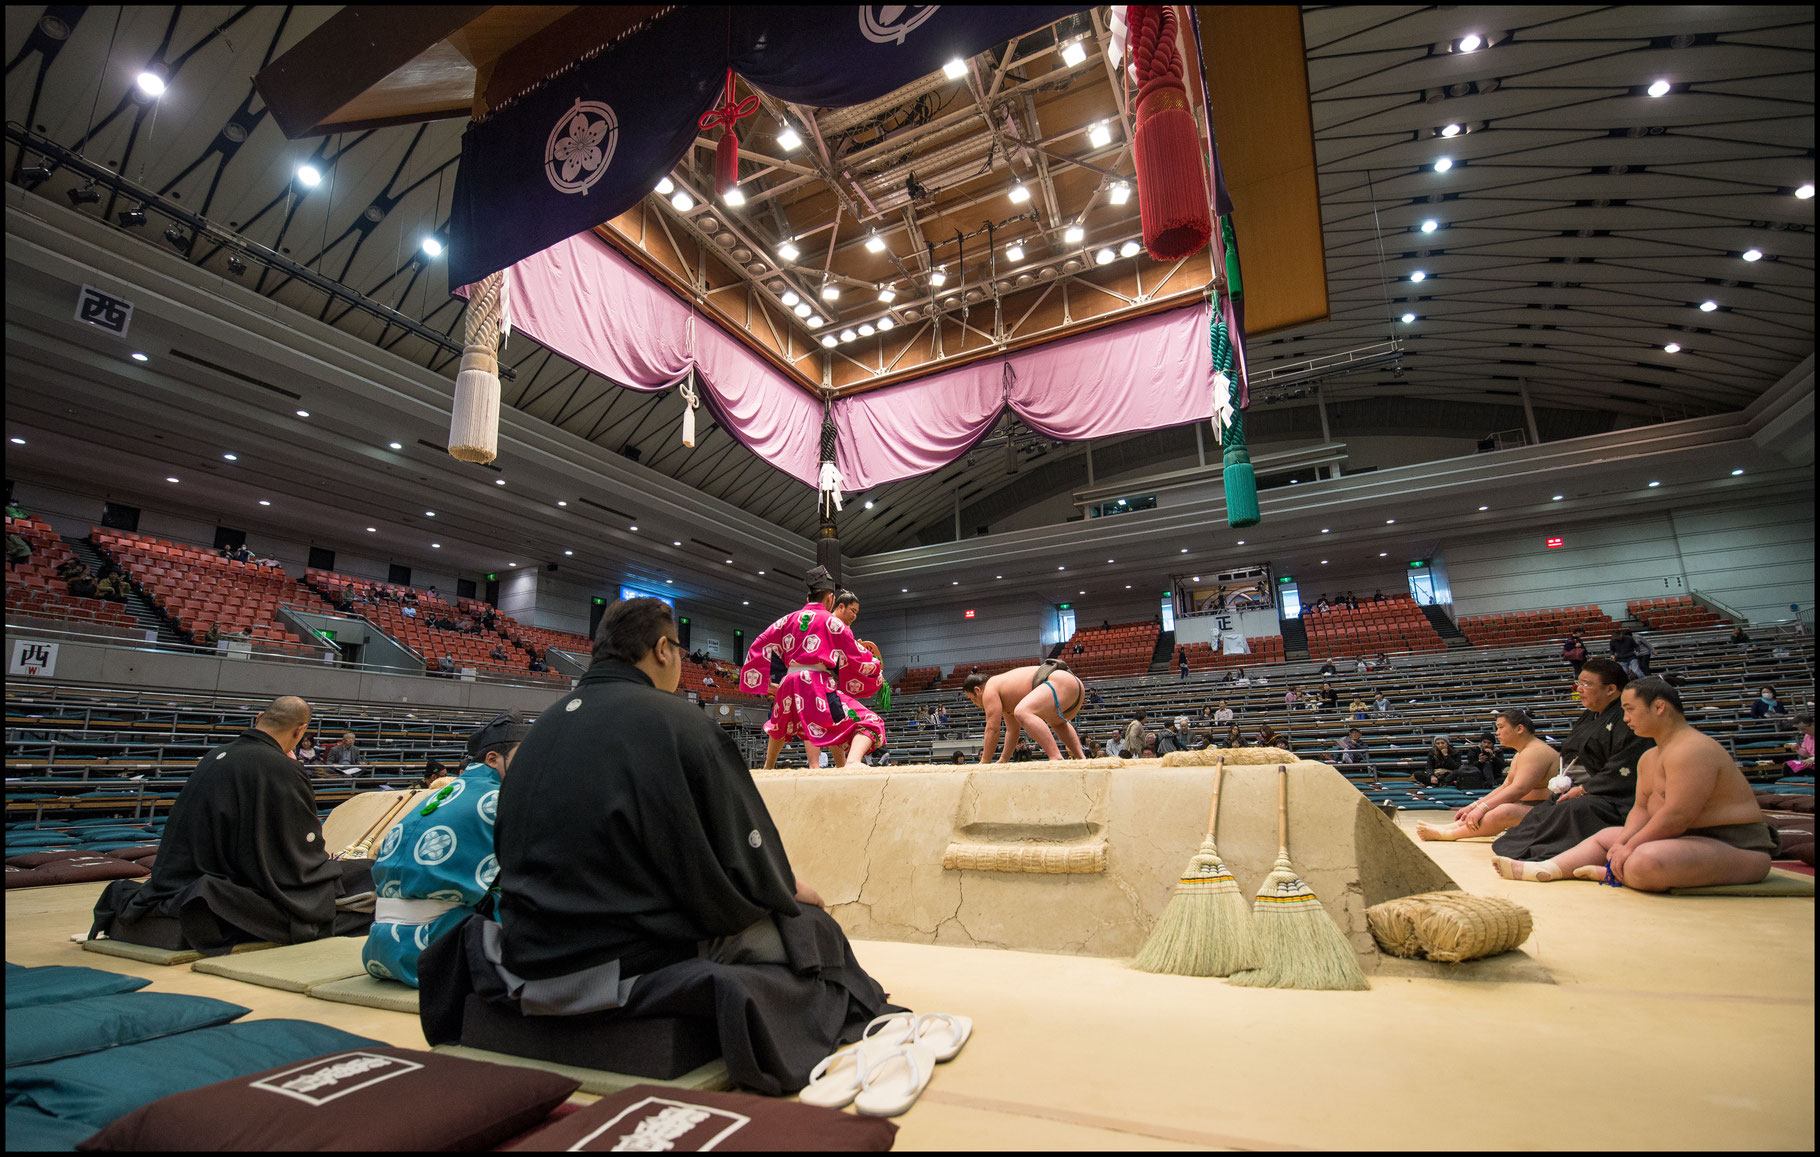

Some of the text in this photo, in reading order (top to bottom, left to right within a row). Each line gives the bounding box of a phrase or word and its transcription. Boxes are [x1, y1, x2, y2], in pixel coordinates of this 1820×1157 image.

[81, 289, 130, 332] 西
[1216, 615, 1233, 631] 正
[20, 643, 51, 667] 西
[28, 666, 38, 675] W
